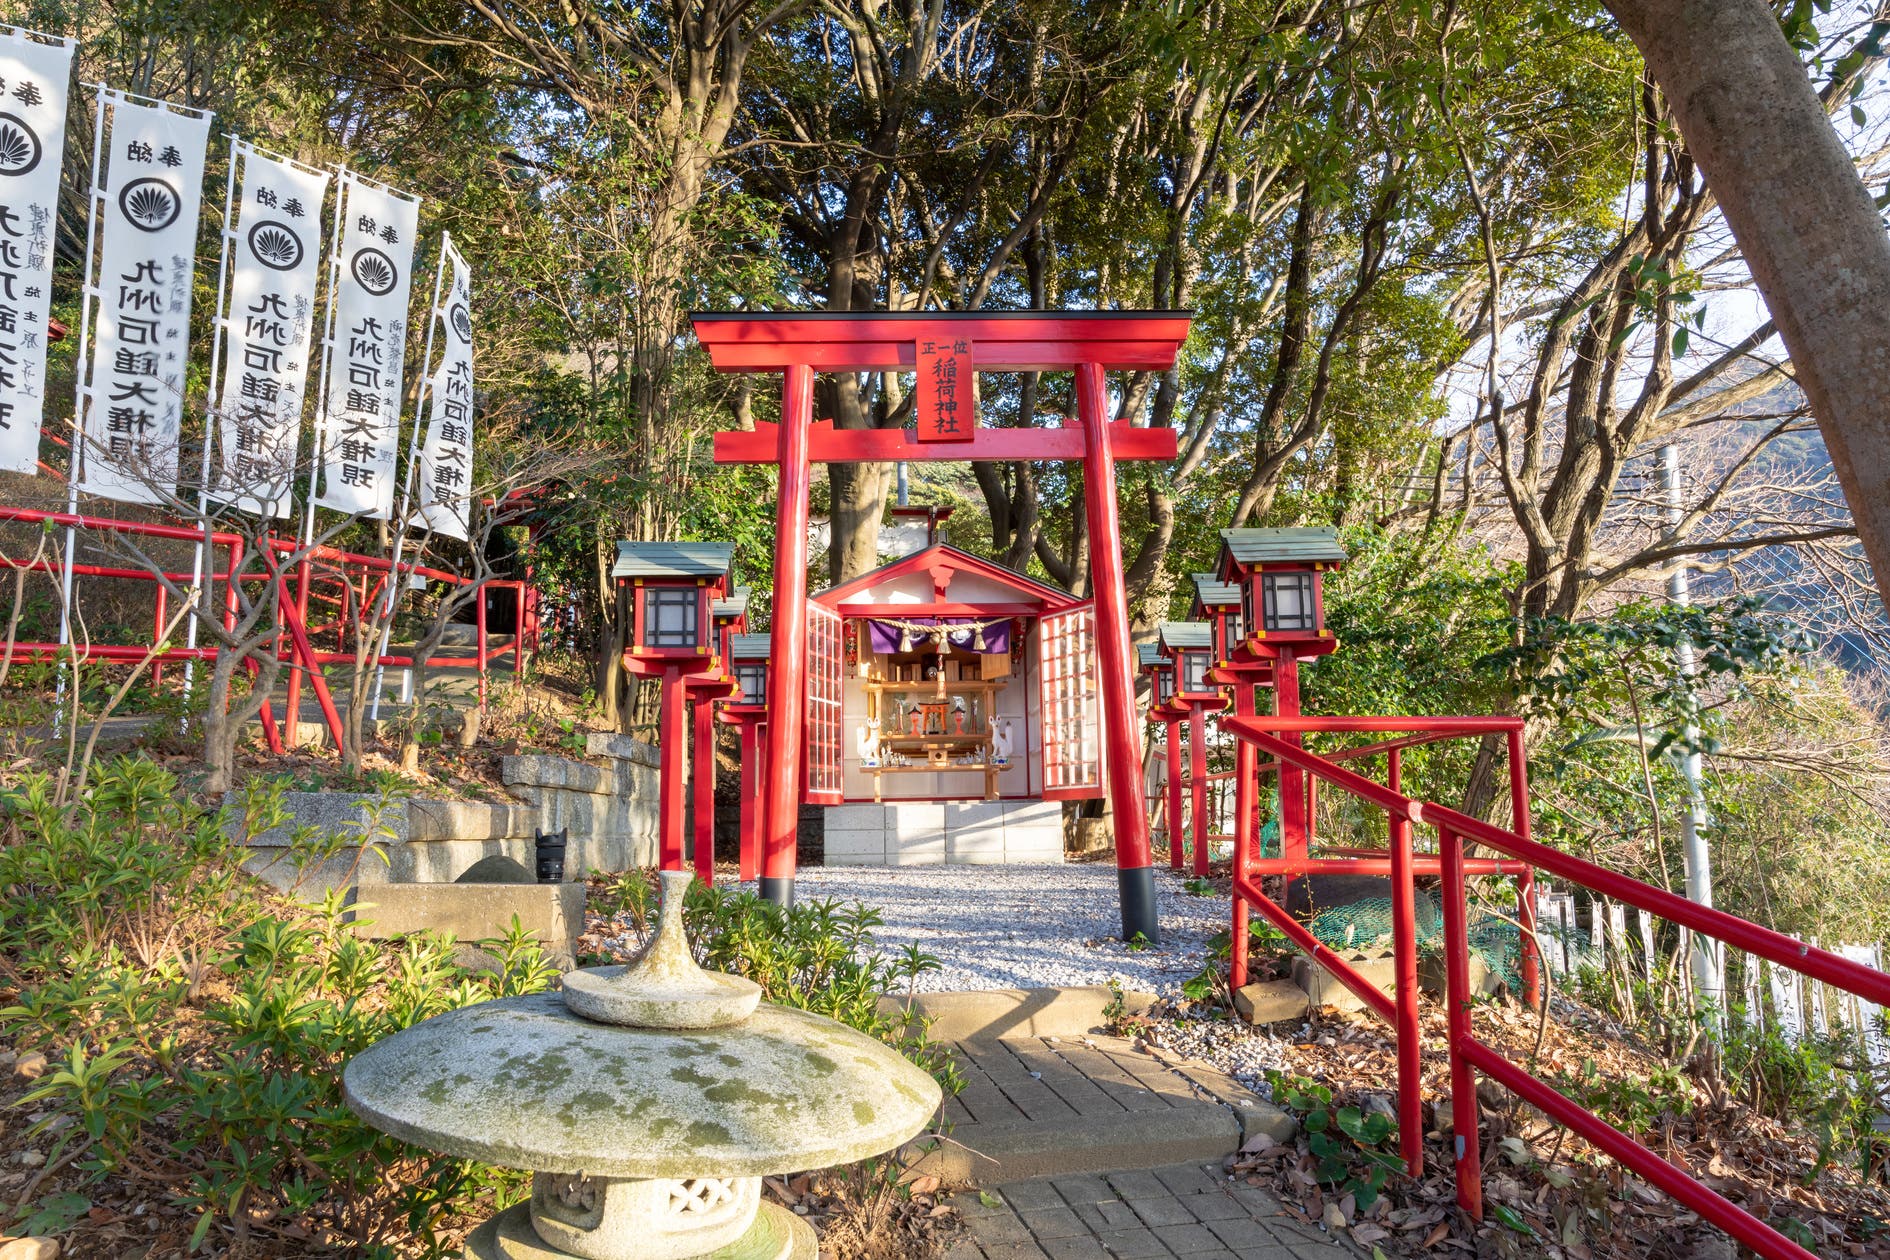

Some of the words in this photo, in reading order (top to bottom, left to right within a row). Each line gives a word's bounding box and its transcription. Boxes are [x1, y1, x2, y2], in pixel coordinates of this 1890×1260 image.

[921, 340, 968, 355] 正一位
[933, 357, 960, 434] 稲荷神社
